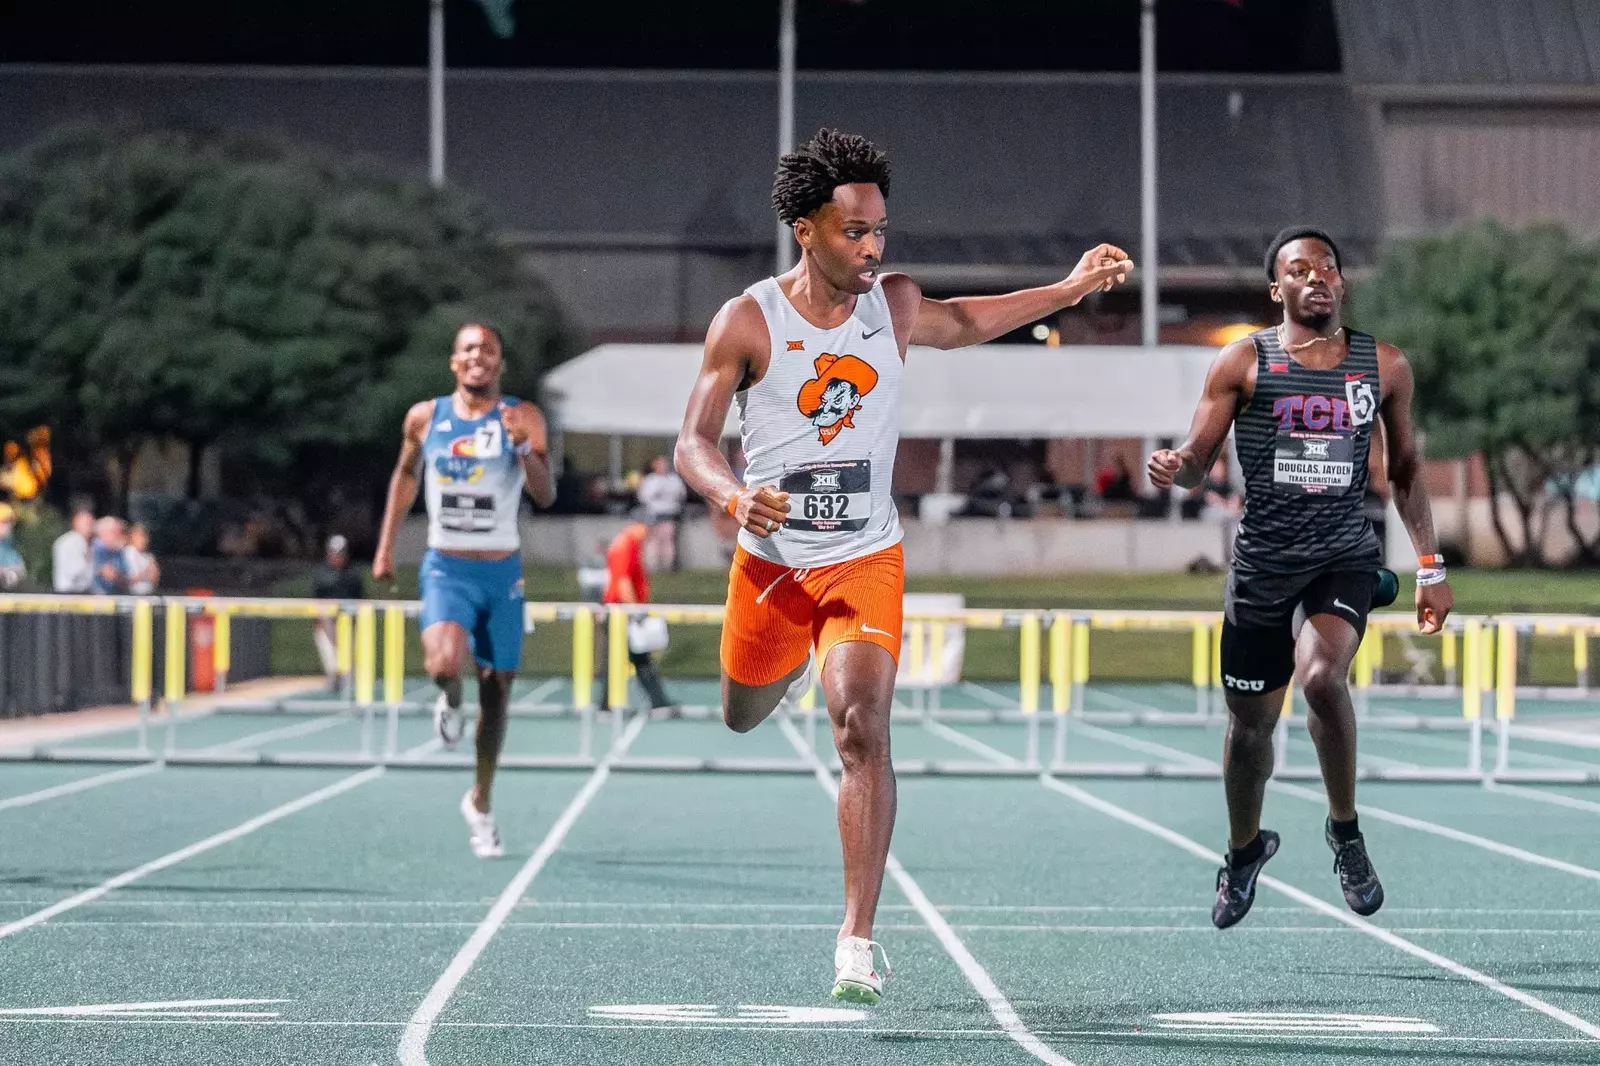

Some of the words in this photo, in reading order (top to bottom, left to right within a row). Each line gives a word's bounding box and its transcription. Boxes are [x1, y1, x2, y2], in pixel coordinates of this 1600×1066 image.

[1352, 384, 1372, 420] 5
[482, 431, 494, 449] 7
[1278, 462, 1321, 475] DOUGLAS,
[1322, 464, 1351, 475] JAYDEN
[1288, 475, 1308, 483] TEXAS
[1308, 476, 1342, 484] CHRISTIAN
[803, 494, 850, 520] 632
[1225, 674, 1265, 692] TCU
